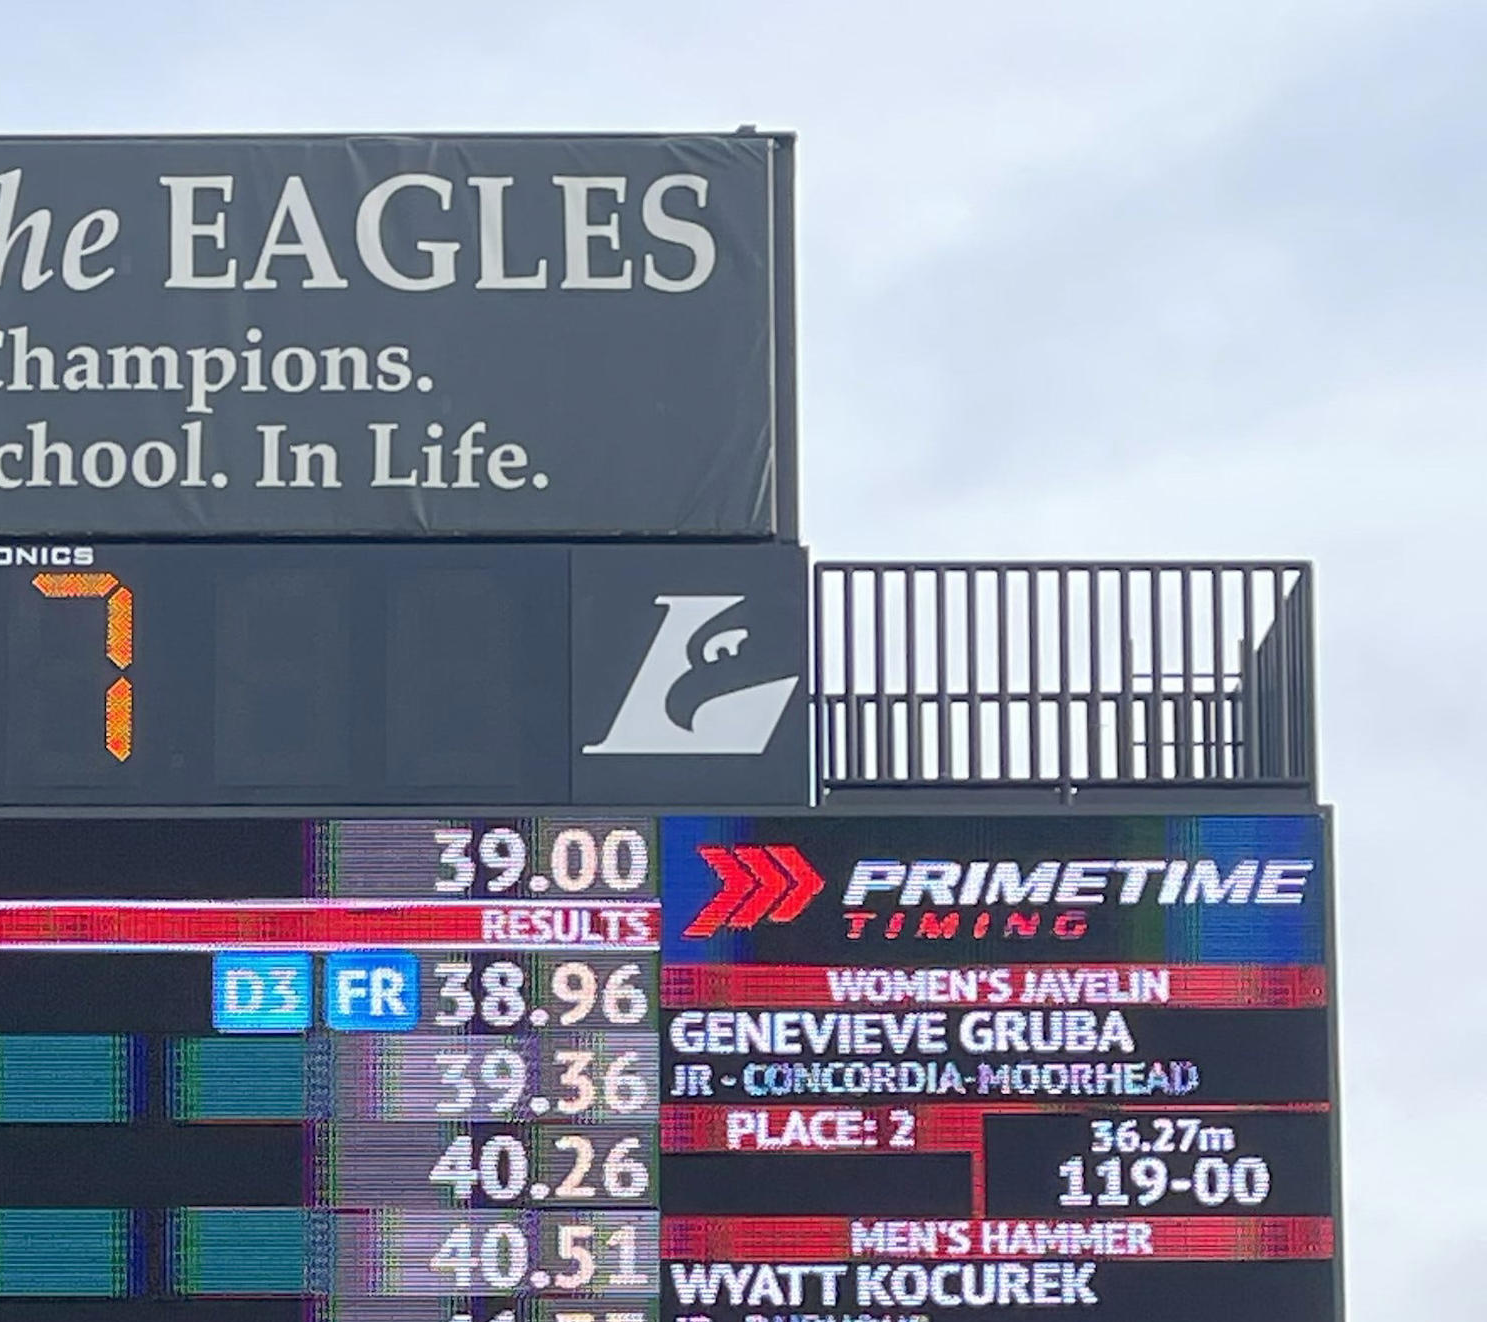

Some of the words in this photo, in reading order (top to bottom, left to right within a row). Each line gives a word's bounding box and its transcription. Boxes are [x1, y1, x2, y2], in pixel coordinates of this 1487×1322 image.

[159, 173, 718, 295] EAGLES
[256, 424, 337, 489] In
[368, 421, 550, 491] Life.
[434, 828, 648, 893] 39.00
[842, 858, 1314, 906] PRIMETIME
[482, 909, 651, 943] RESULTS
[842, 912, 1088, 940] TIMING
[224, 968, 300, 1016] D3
[336, 968, 407, 1017] FR
[434, 962, 648, 1027] 38.96
[826, 969, 1011, 1004] WOMEN'S
[1018, 970, 1170, 1004] JAVELIN
[670, 1010, 947, 1055] GENEVIEVE
[960, 1010, 1134, 1055] GRUBA
[434, 1049, 649, 1116] 39.36
[670, 1064, 713, 1097] JR
[744, 1062, 1199, 1097] CONCORDIA-MOORHEAD
[726, 1110, 878, 1150] PLACE:
[890, 1110, 916, 1147] 2
[1091, 1118, 1235, 1153] 36.27m
[429, 1135, 649, 1200] 40.26
[1058, 1155, 1270, 1208] 119-00
[429, 1223, 648, 1289] 40.51
[850, 1221, 971, 1256] MEN'S
[982, 1221, 1154, 1256] HAMMER
[669, 1263, 847, 1306] WYATT
[857, 1262, 1098, 1307] KOCUREK
